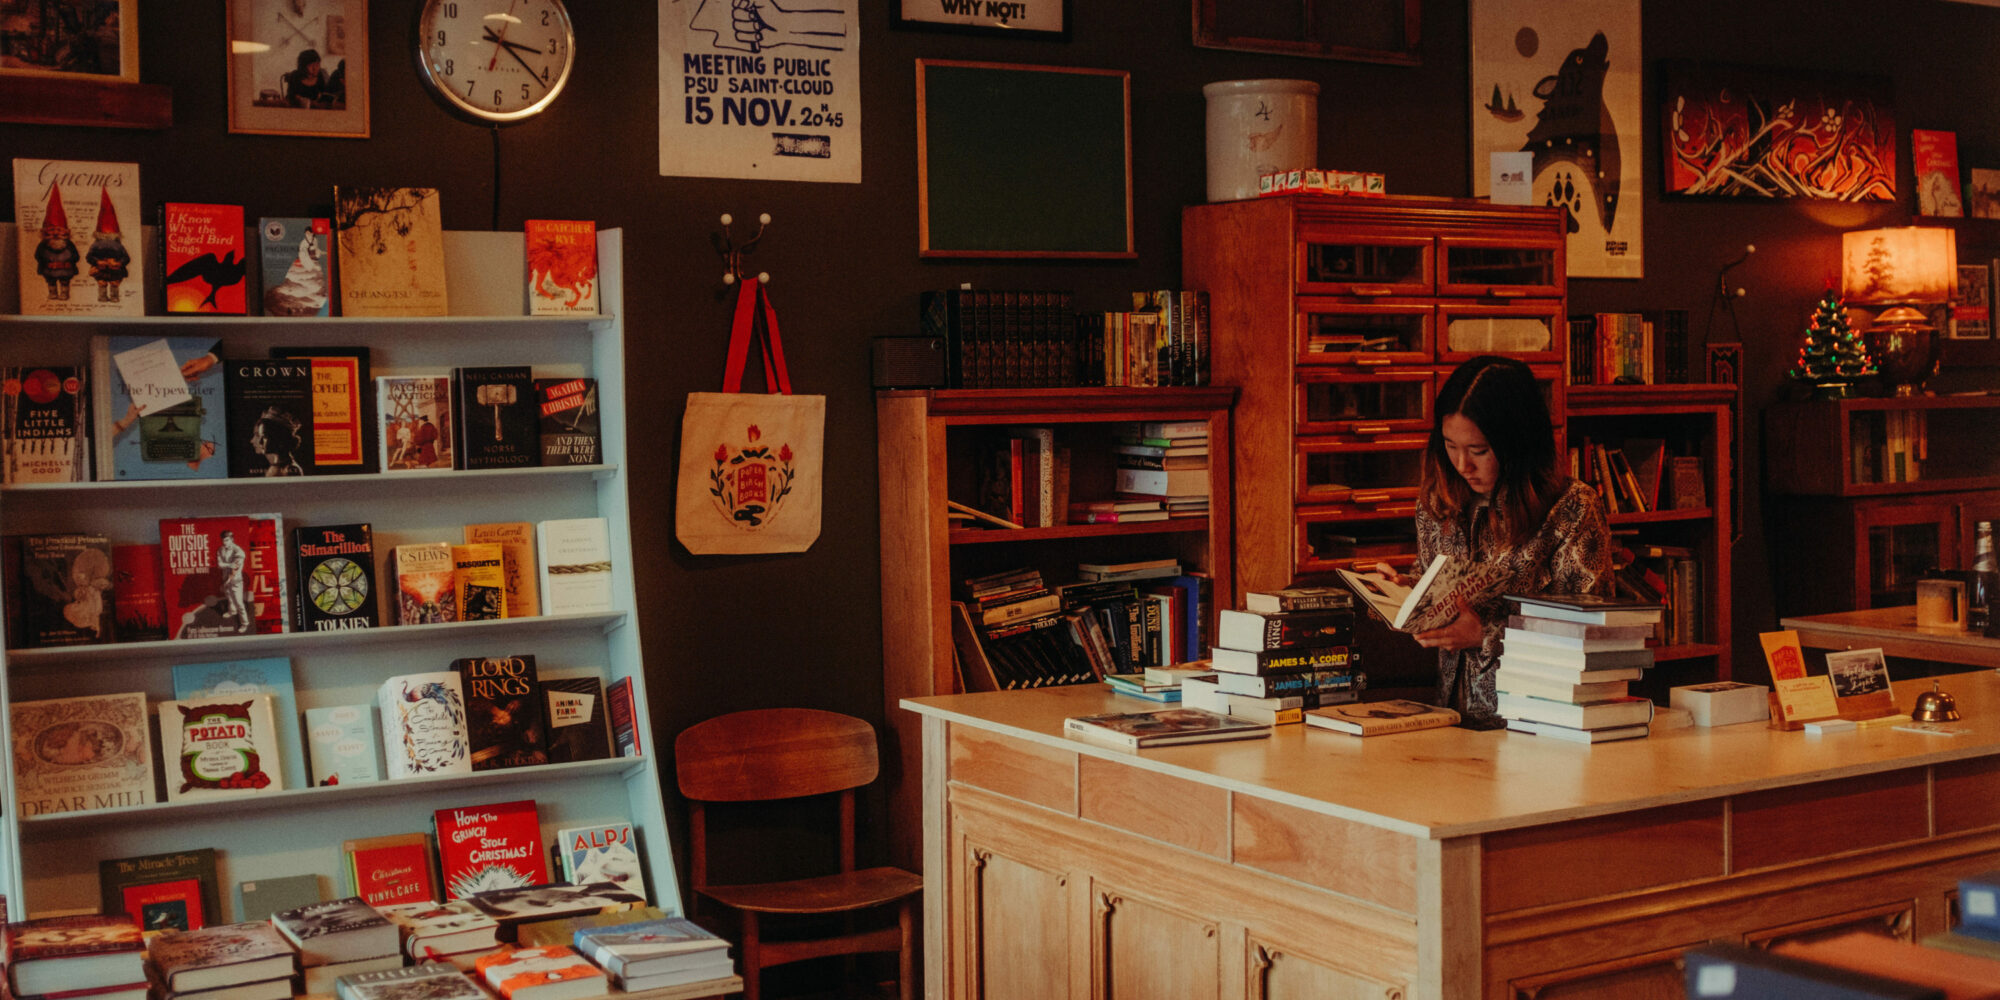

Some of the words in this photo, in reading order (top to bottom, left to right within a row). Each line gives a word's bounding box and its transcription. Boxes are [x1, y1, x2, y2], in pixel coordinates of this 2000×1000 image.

[444, 1, 457, 19] 10
[941, 0, 981, 15] WHY
[986, 1, 1026, 23] NOT!
[541, 10, 550, 26] 2
[437, 31, 446, 46] 9
[549, 38, 557, 54] 3
[445, 59, 454, 75] 8
[683, 53, 766, 75] MEETING
[773, 58, 831, 76] PUBLIC
[541, 66, 549, 82] 4
[467, 80, 476, 97] 7
[521, 83, 530, 100] 5
[685, 76, 718, 94] PSU
[494, 89, 502, 106] 6
[685, 96, 713, 124] 15
[722, 97, 796, 126] NOV.
[1255, 101, 1273, 121] 4
[38, 161, 124, 202] Gnomes
[170, 213, 175, 223] I
[178, 213, 213, 224] Know
[170, 223, 194, 234] Why
[198, 225, 216, 234] the
[545, 223, 592, 233] CATCHER
[168, 233, 205, 246] Caged
[207, 235, 234, 245] Bird
[555, 235, 575, 244] RYE
[170, 245, 200, 256] Sings
[239, 366, 307, 377] CROWN
[490, 371, 527, 380] GAIMAN
[117, 383, 143, 397] The
[144, 383, 215, 398] Typewriter
[311, 383, 347, 393] OPHET
[393, 383, 441, 392] ALCHEMY
[550, 382, 585, 400] AGATHA
[542, 393, 584, 414] CHRISTIE
[29, 410, 58, 418] FIVE
[24, 419, 66, 428] LITTLE
[17, 428, 72, 437] INDIANS
[555, 436, 573, 446] AND
[574, 436, 595, 446] THEN
[483, 445, 516, 453] NORSE
[546, 445, 572, 456] THERE
[573, 445, 595, 455] WERE
[22, 460, 71, 468] MICHELLE
[469, 455, 530, 465] MYTHOLOGY
[569, 455, 594, 464] NONE
[740, 465, 765, 479] PAPER
[740, 478, 764, 490] BIRCH
[739, 490, 764, 502] BOOKS
[180, 524, 195, 535] THE
[322, 531, 346, 543] The
[168, 534, 209, 551] OUTSIDE
[300, 542, 371, 557] Silmarillion
[170, 550, 211, 569] CIRCLE
[456, 559, 500, 569] SASQUATCH
[1427, 576, 1476, 620] SIBERIAN
[1444, 572, 1495, 618] DILMMA
[1129, 604, 1140, 622] The
[1146, 605, 1157, 632] DUNE
[314, 617, 370, 631] TOLKIEN
[1033, 618, 1058, 630] TOLKIEN
[1271, 619, 1282, 649] KING
[1129, 624, 1142, 662] Godfather
[470, 658, 527, 678] LORD
[1269, 657, 1298, 668] JAMES
[1299, 657, 1308, 665] S.
[1309, 656, 1318, 664] A.
[1319, 654, 1349, 663] COREY
[472, 677, 531, 700] RINGS
[1274, 680, 1303, 690] JAMES
[1324, 675, 1352, 684] COREY
[556, 708, 577, 716] FARM
[189, 725, 246, 742] POTATO
[206, 742, 230, 750] BOOK
[87, 771, 119, 780] GRIMM
[19, 796, 87, 817] DEAR
[94, 790, 146, 810] MILI
[454, 811, 480, 828] How
[481, 813, 498, 823] The
[451, 826, 487, 844] GRINCH
[574, 827, 630, 852] ALPS
[480, 837, 508, 850] STOLE
[118, 861, 136, 873] The
[138, 857, 175, 871] Miracle
[176, 855, 199, 867] Tree
[371, 865, 412, 881] Christmas
[367, 889, 396, 903] VINYL
[396, 881, 420, 897] CAFE
